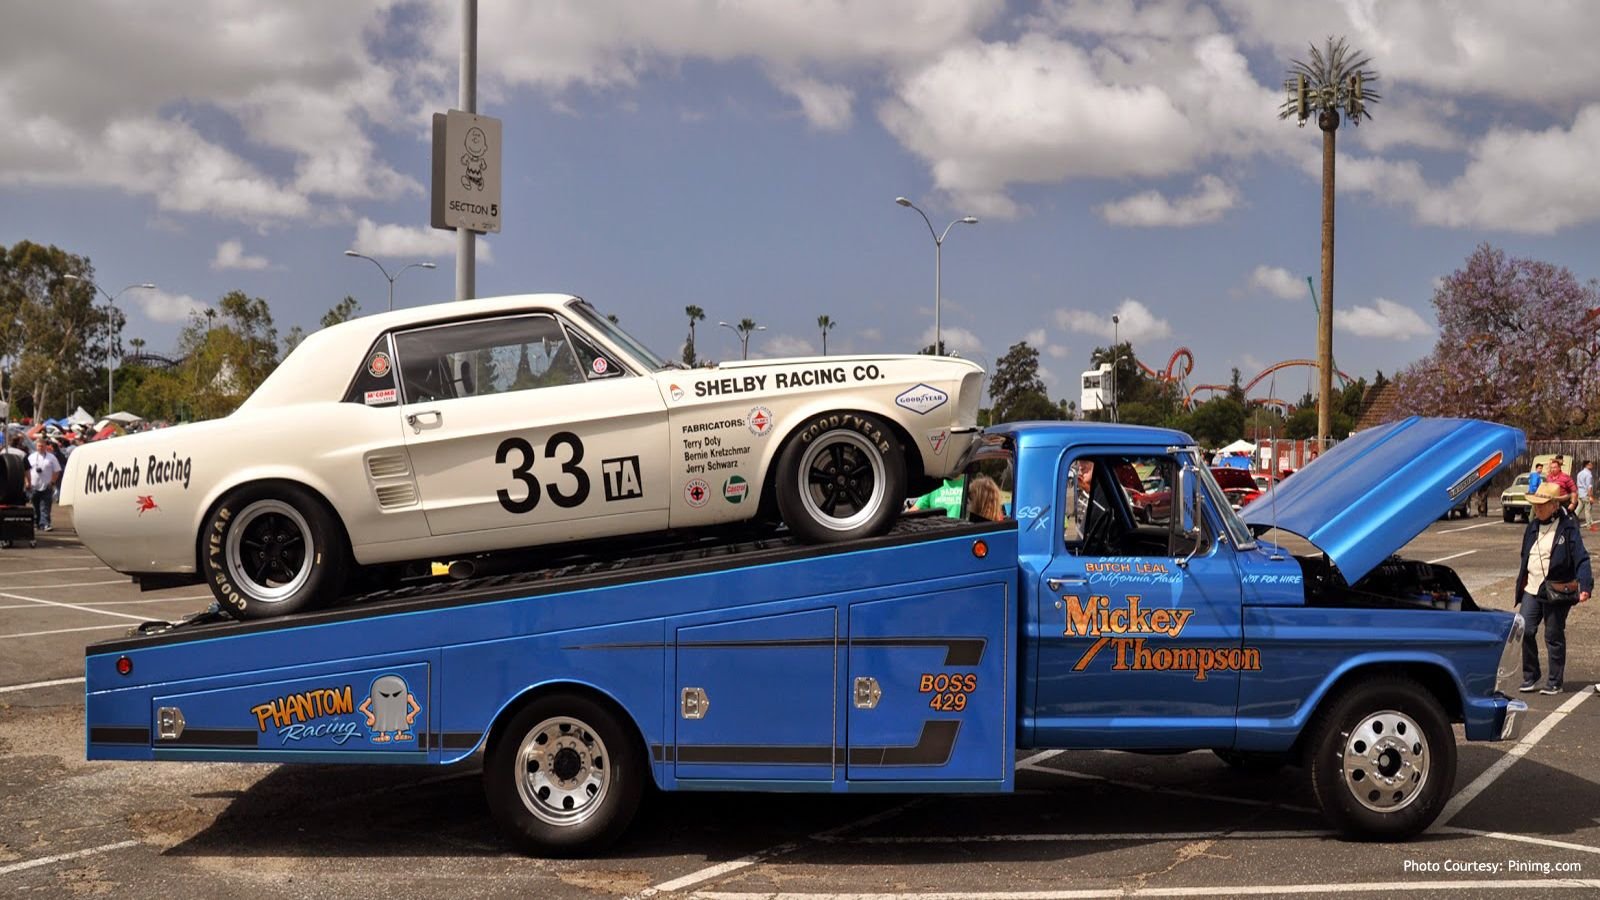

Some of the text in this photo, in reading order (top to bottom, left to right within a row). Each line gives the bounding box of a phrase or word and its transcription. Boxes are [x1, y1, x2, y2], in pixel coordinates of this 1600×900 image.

[449, 200, 498, 217] SECTION 5
[694, 364, 885, 397] SHELBY RACING CO.
[682, 419, 745, 433] FABRICATORS:
[683, 435, 721, 449] Terry Doty
[684, 446, 751, 461] Bernie Kretzchmar
[85, 450, 192, 495] McComb Racing
[495, 431, 590, 514] 33
[686, 460, 738, 474] Jerry Schwarz
[602, 458, 642, 498] TA
[1085, 562, 1169, 573] BUTCH LEAL
[1242, 574, 1302, 584] NOT FOR HIRE
[1062, 594, 1195, 638] Mickey
[1112, 636, 1262, 681] Thompson
[919, 673, 977, 693] BOSS
[251, 685, 354, 732] PHANTOM
[929, 692, 967, 712] 429
[278, 717, 363, 745] Racing
